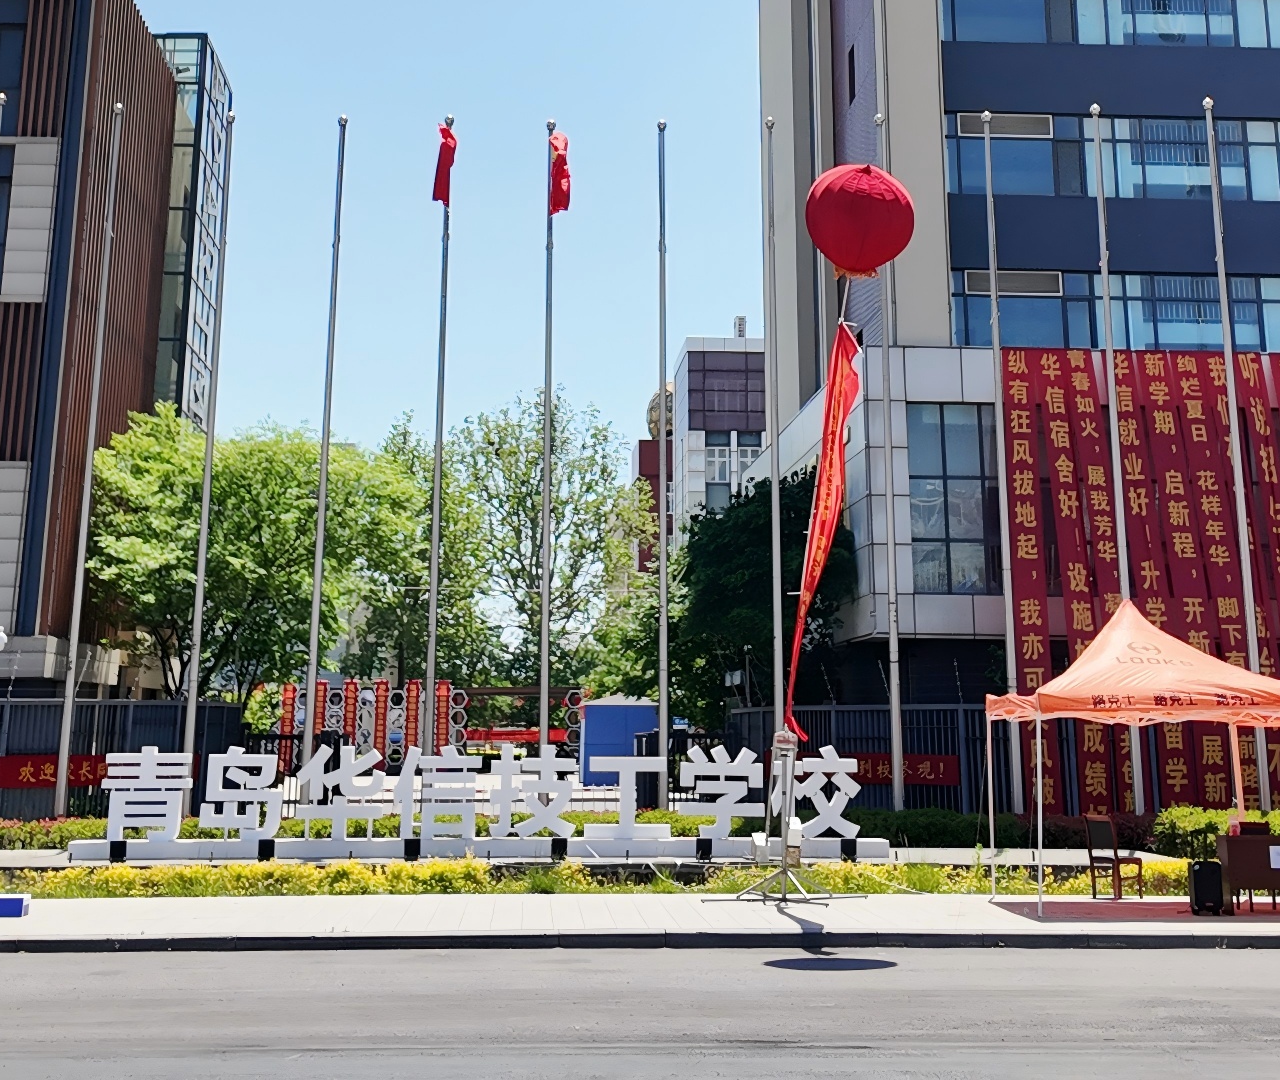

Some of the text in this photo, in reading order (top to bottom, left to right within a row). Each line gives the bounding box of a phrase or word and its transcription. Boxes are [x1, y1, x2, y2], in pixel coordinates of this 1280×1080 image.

[100, 744, 861, 841] 青岛华信技工学校
